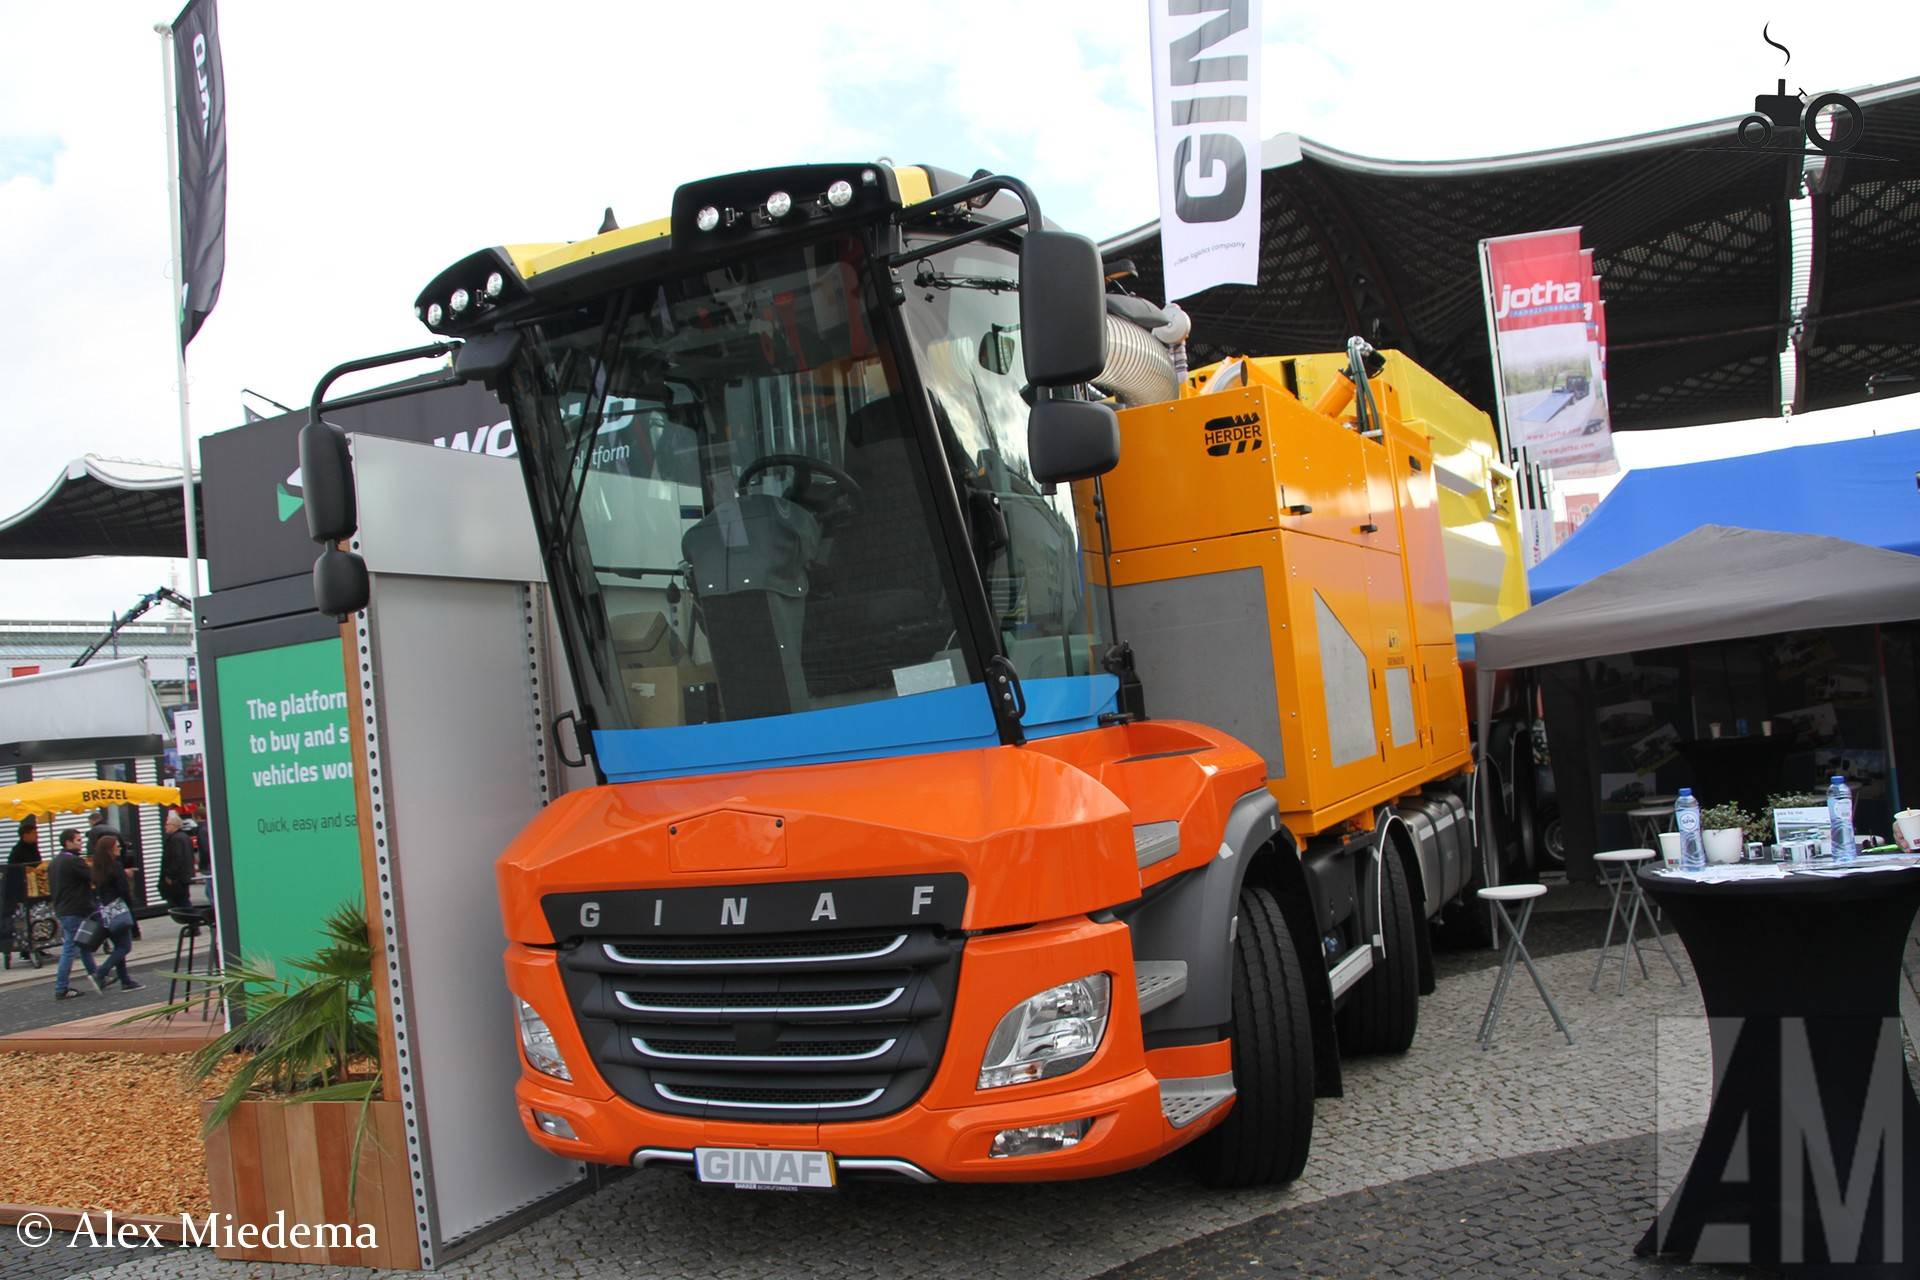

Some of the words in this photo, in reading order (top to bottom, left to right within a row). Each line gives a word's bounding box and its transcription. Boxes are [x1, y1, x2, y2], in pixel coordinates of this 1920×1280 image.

[1495, 280, 1582, 320] jotha
[1204, 424, 1262, 446] HERDER
[246, 698, 277, 721] The
[184, 720, 193, 733] P
[250, 734, 267, 754] to
[270, 730, 300, 755] buy
[304, 722, 335, 748] and
[252, 761, 318, 787] vehicles
[82, 789, 129, 802] BREZEL
[257, 816, 290, 835] Quick,
[292, 817, 318, 832] easy
[321, 812, 342, 829] and
[579, 885, 935, 928] GINAF
[702, 1150, 823, 1184] GINAF
